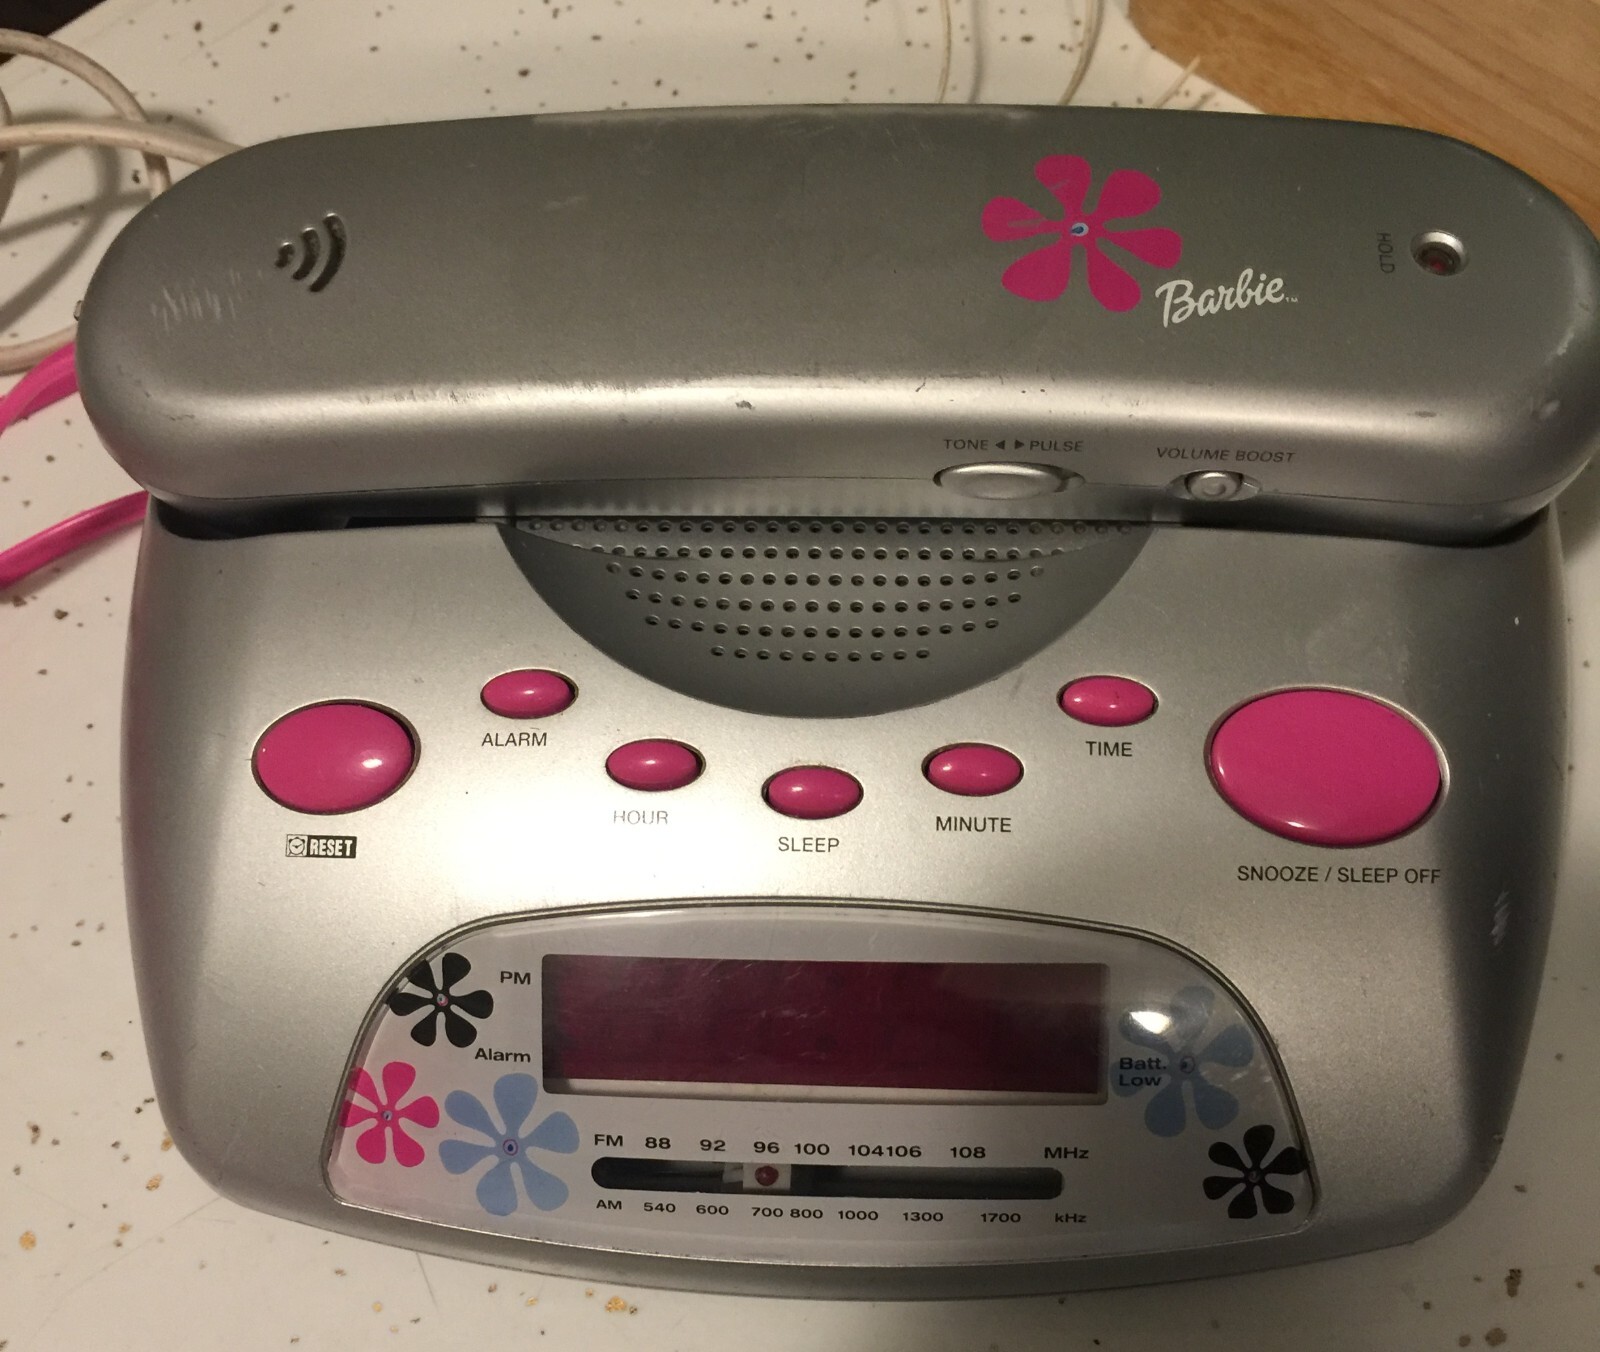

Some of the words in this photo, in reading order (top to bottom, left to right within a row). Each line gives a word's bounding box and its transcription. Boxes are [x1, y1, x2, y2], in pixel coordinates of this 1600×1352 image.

[1376, 231, 1395, 274] HOLD
[1155, 268, 1286, 328] Barbie
[943, 439, 989, 451] TONE
[1029, 440, 1084, 453] PULSE
[1156, 447, 1231, 462] VOLUME
[1235, 450, 1296, 463] BOOST
[481, 731, 548, 748] ALARM
[1085, 740, 1133, 757] TIME
[612, 809, 669, 826] HOUR
[935, 816, 1012, 833] MINUTE
[308, 837, 355, 858] RESET
[778, 836, 840, 853] SLEEP
[1237, 865, 1319, 882] SNOOZE
[1337, 866, 1398, 883] SLEEP
[1404, 868, 1441, 884] OFF
[500, 970, 531, 985] PM
[474, 1048, 531, 1063] Alarm
[1119, 1057, 1167, 1070] Batt.
[1119, 1074, 1162, 1087] Low
[594, 1134, 623, 1147] FM
[645, 1136, 671, 1149] 88
[700, 1139, 726, 1152] 92
[753, 1141, 780, 1154] 96
[794, 1143, 830, 1156] 100
[950, 1146, 986, 1159] 108
[1044, 1146, 1089, 1159] MHz
[596, 1199, 622, 1210] AM
[643, 1202, 676, 1213] 540
[696, 1204, 729, 1215] 600
[752, 1207, 784, 1218] 700
[789, 1208, 824, 1219] 800
[837, 1210, 879, 1221] 1000
[902, 1211, 944, 1222] 1300
[980, 1212, 1021, 1223] 1700
[1054, 1212, 1087, 1223] kHz
